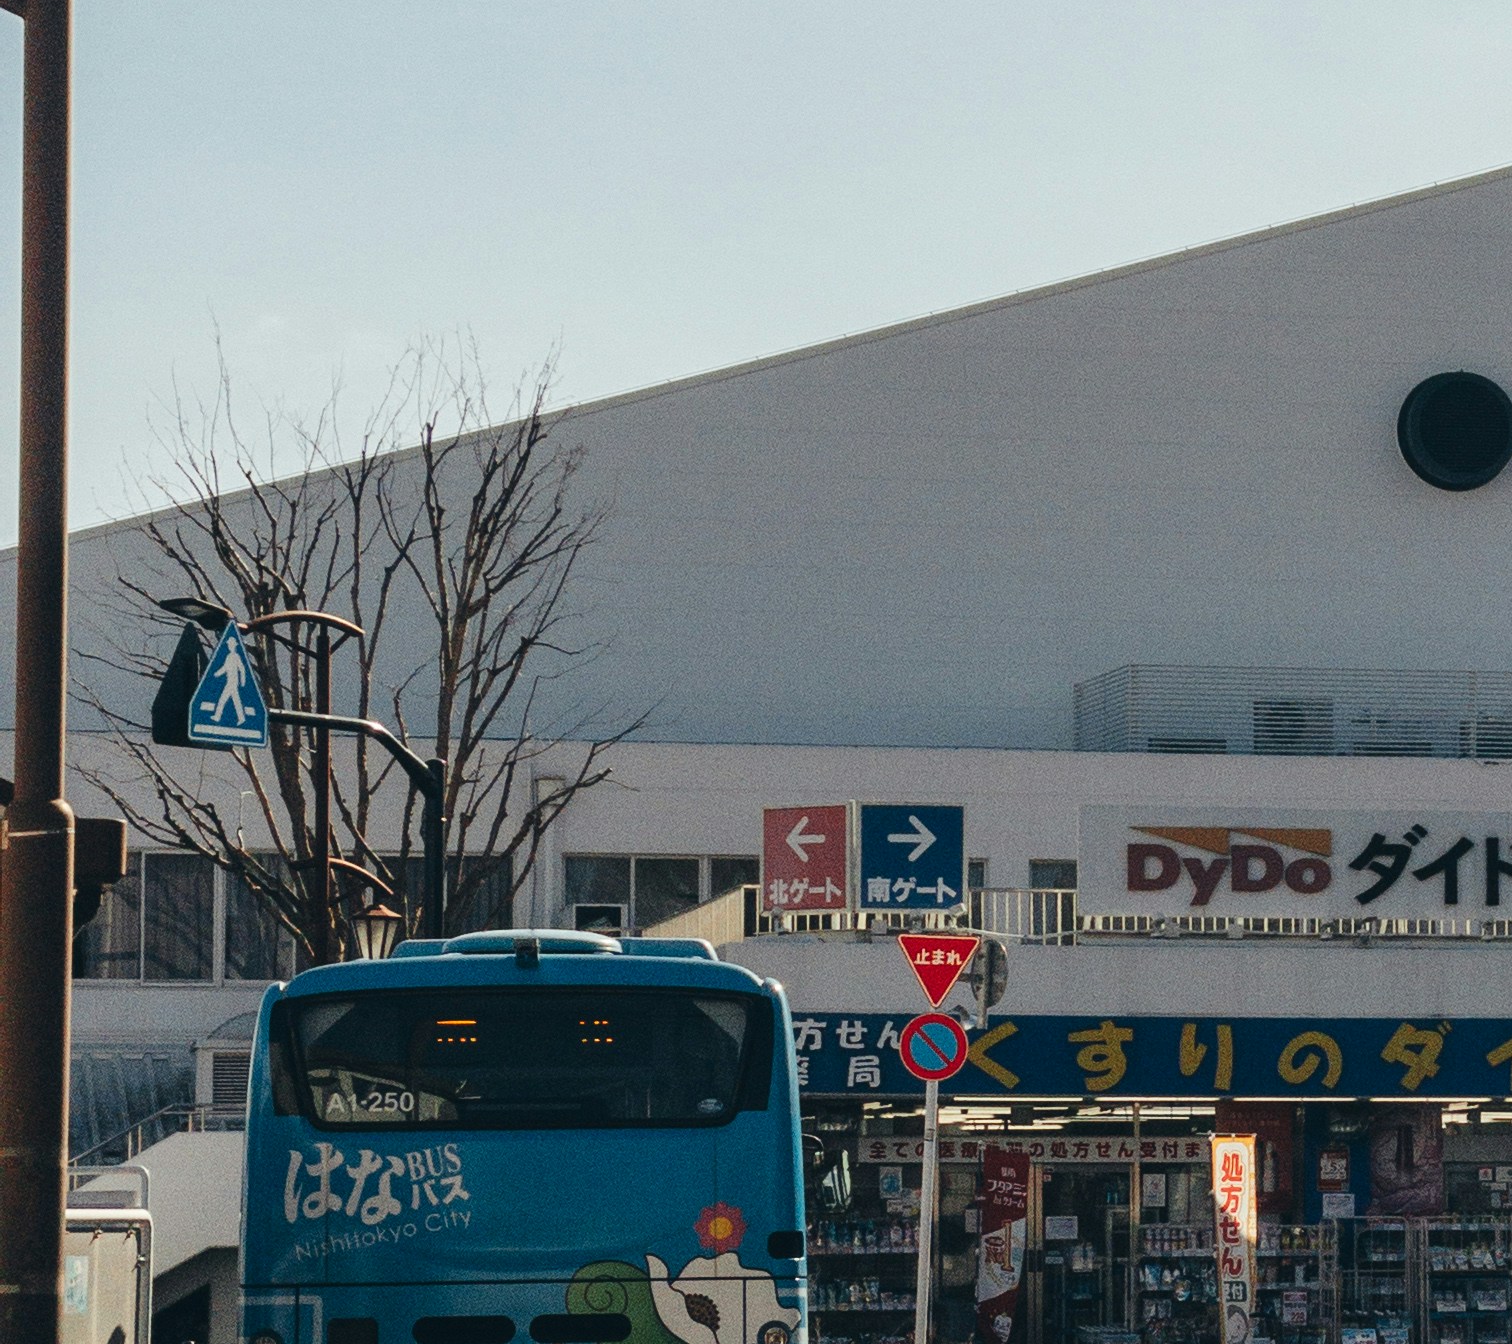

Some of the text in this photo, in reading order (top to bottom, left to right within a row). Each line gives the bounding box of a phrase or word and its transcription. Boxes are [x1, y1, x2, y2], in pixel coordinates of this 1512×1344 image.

[867, 876, 957, 903] 南ゲート
[1127, 843, 1332, 906] DyDo
[769, 877, 842, 904] 北ゲート
[914, 948, 963, 966] 止まれ
[326, 1092, 414, 1113] A1-250
[406, 1143, 462, 1181] BUS
[284, 1142, 405, 1225] はな
[411, 1175, 470, 1210] バス
[425, 1210, 471, 1233] City
[1220, 1152, 1243, 1277] 処方せん
